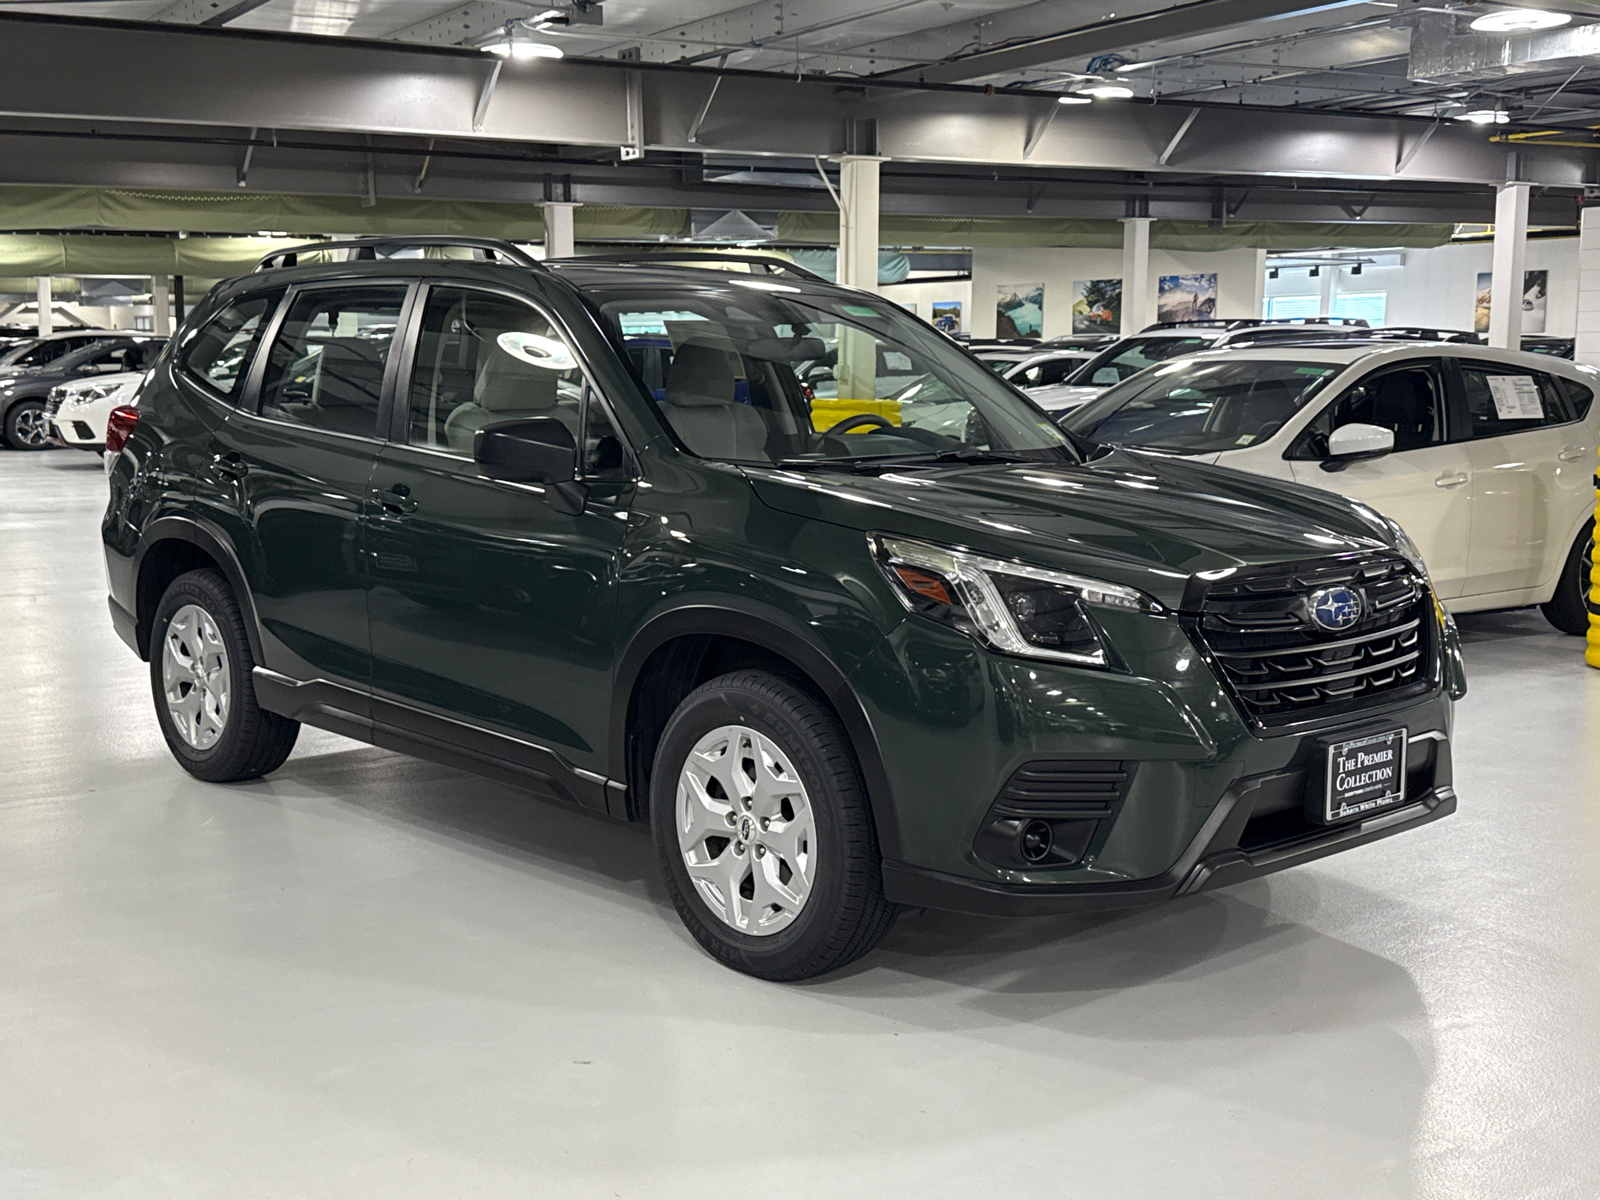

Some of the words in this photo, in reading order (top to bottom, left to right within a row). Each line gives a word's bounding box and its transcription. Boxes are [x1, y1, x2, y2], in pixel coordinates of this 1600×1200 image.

[1337, 757, 1356, 773] THE
[1357, 749, 1394, 768] PREMIER
[1336, 766, 1393, 791] COLLECTION
